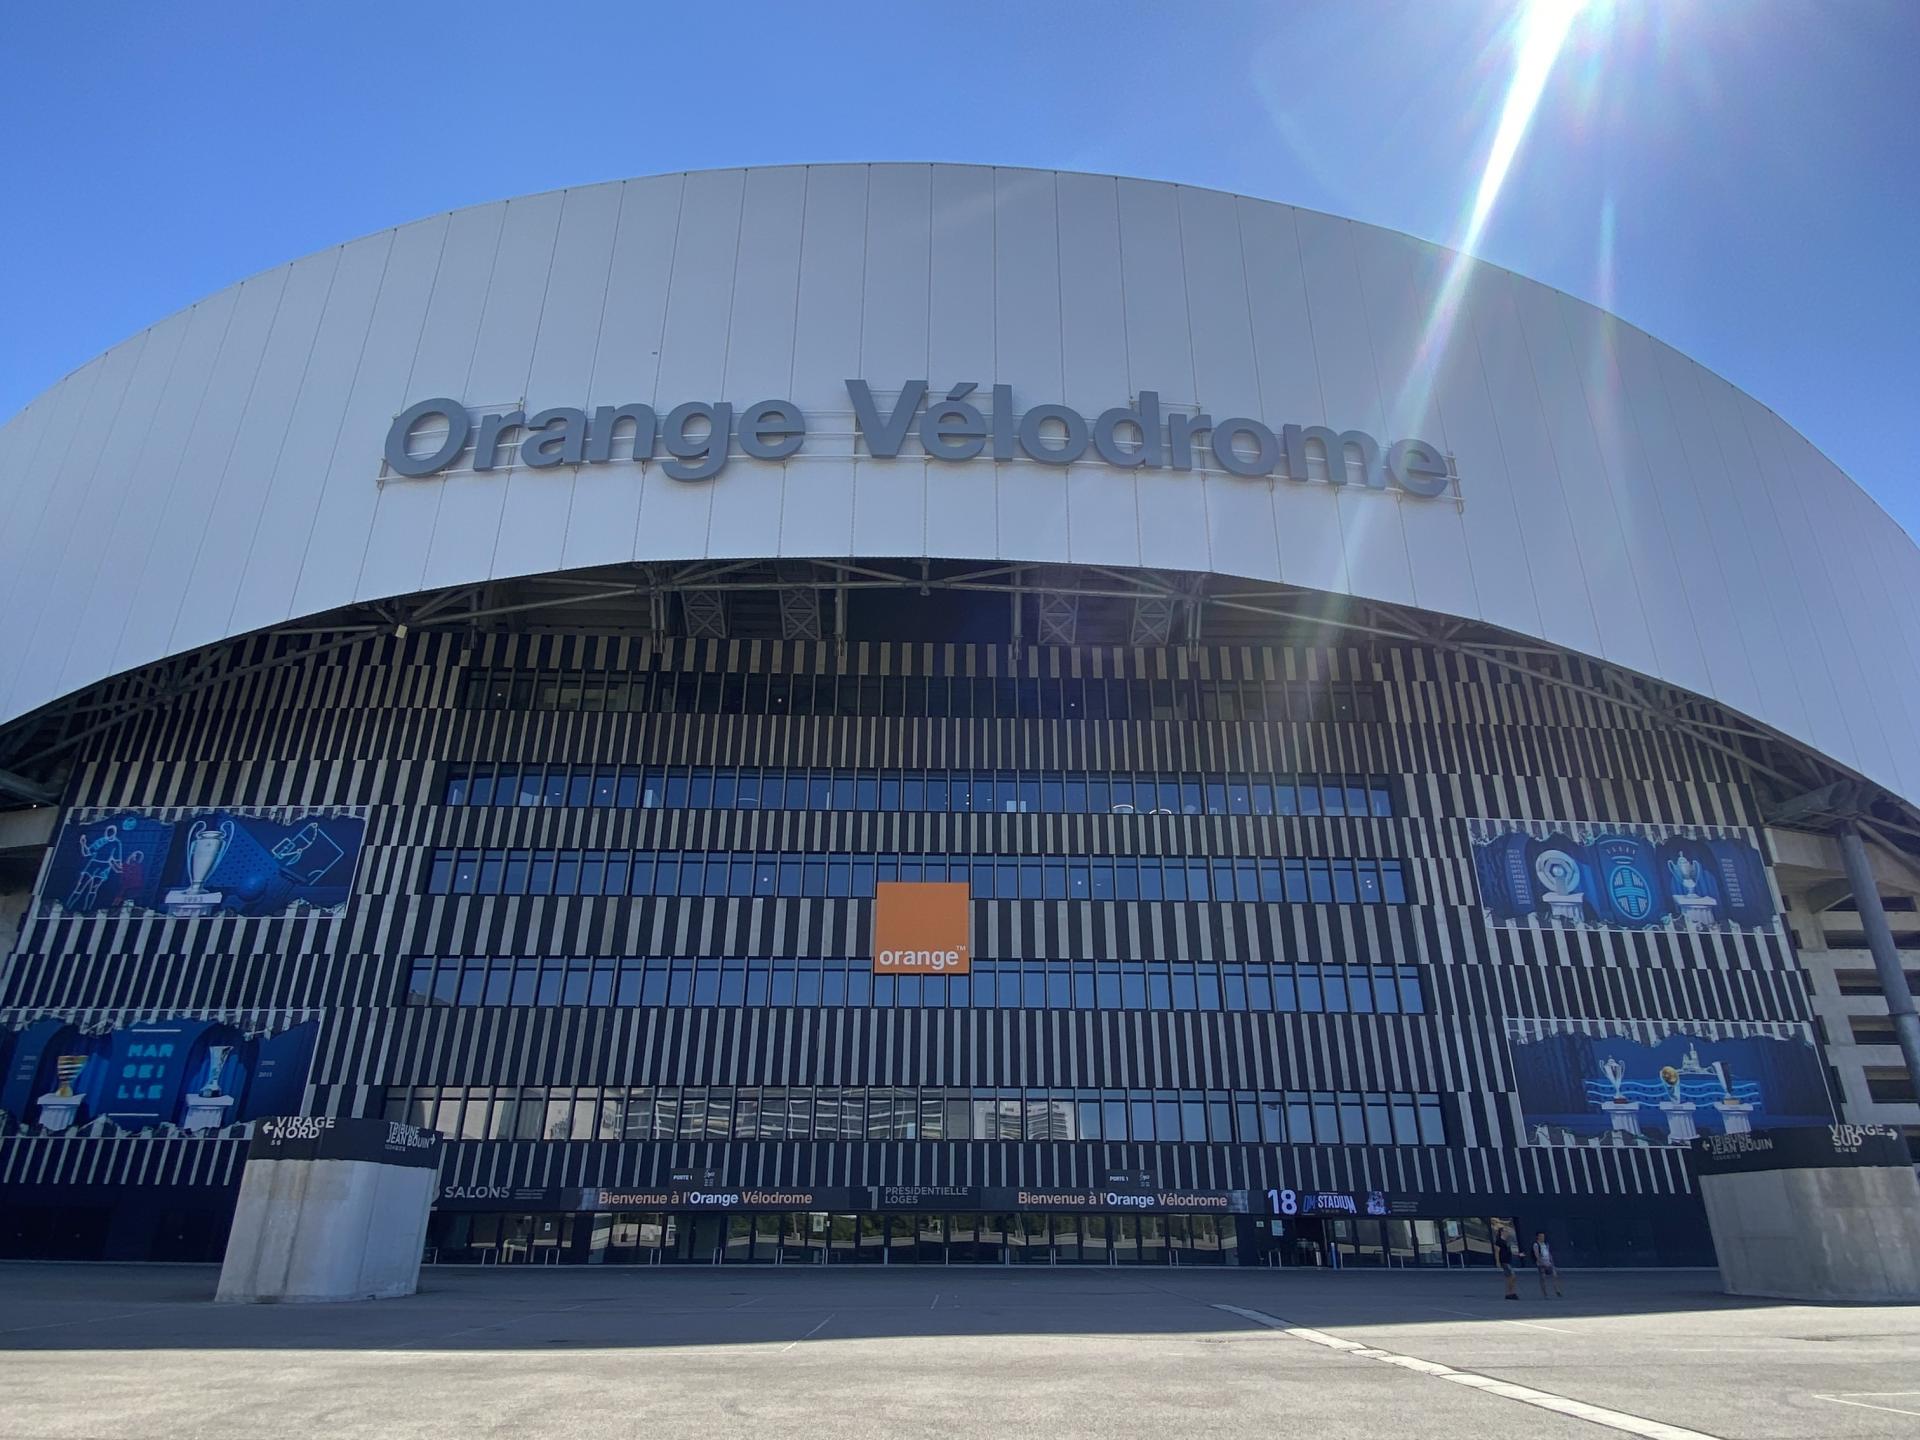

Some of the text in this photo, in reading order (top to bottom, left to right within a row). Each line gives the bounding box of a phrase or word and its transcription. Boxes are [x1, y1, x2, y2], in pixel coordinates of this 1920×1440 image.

[385, 378, 1449, 499] Orange Vélodrome
[879, 949, 959, 970] orange
[127, 1043, 174, 1058] MAR
[122, 1064, 165, 1079] SEI
[117, 1084, 164, 1099] LLE
[276, 1116, 336, 1129] VIRAGE
[389, 1121, 421, 1136] TRIBUNE
[273, 1127, 321, 1139] NORD
[1828, 1124, 1886, 1137] VIRAGE
[386, 1131, 407, 1145] JEAN
[406, 1135, 430, 1149] BOUIN
[1708, 1133, 1752, 1147] TRIBUNE
[1711, 1137, 1774, 1155] JEAN BOUIN
[1832, 1134, 1863, 1147] SUD
[444, 1186, 511, 1199] SALONS
[598, 1191, 668, 1205] Bienvenue
[671, 1190, 680, 1205] à
[742, 1190, 814, 1205] Vélodrome
[867, 1186, 879, 1211] 1
[884, 1195, 919, 1205] LOGES
[1018, 1191, 1086, 1205] Bienvenue
[1088, 1190, 1097, 1205] à
[1157, 1192, 1229, 1206] Vélodrome
[1267, 1188, 1298, 1215] 18
[1317, 1195, 1358, 1215] STADIUM
